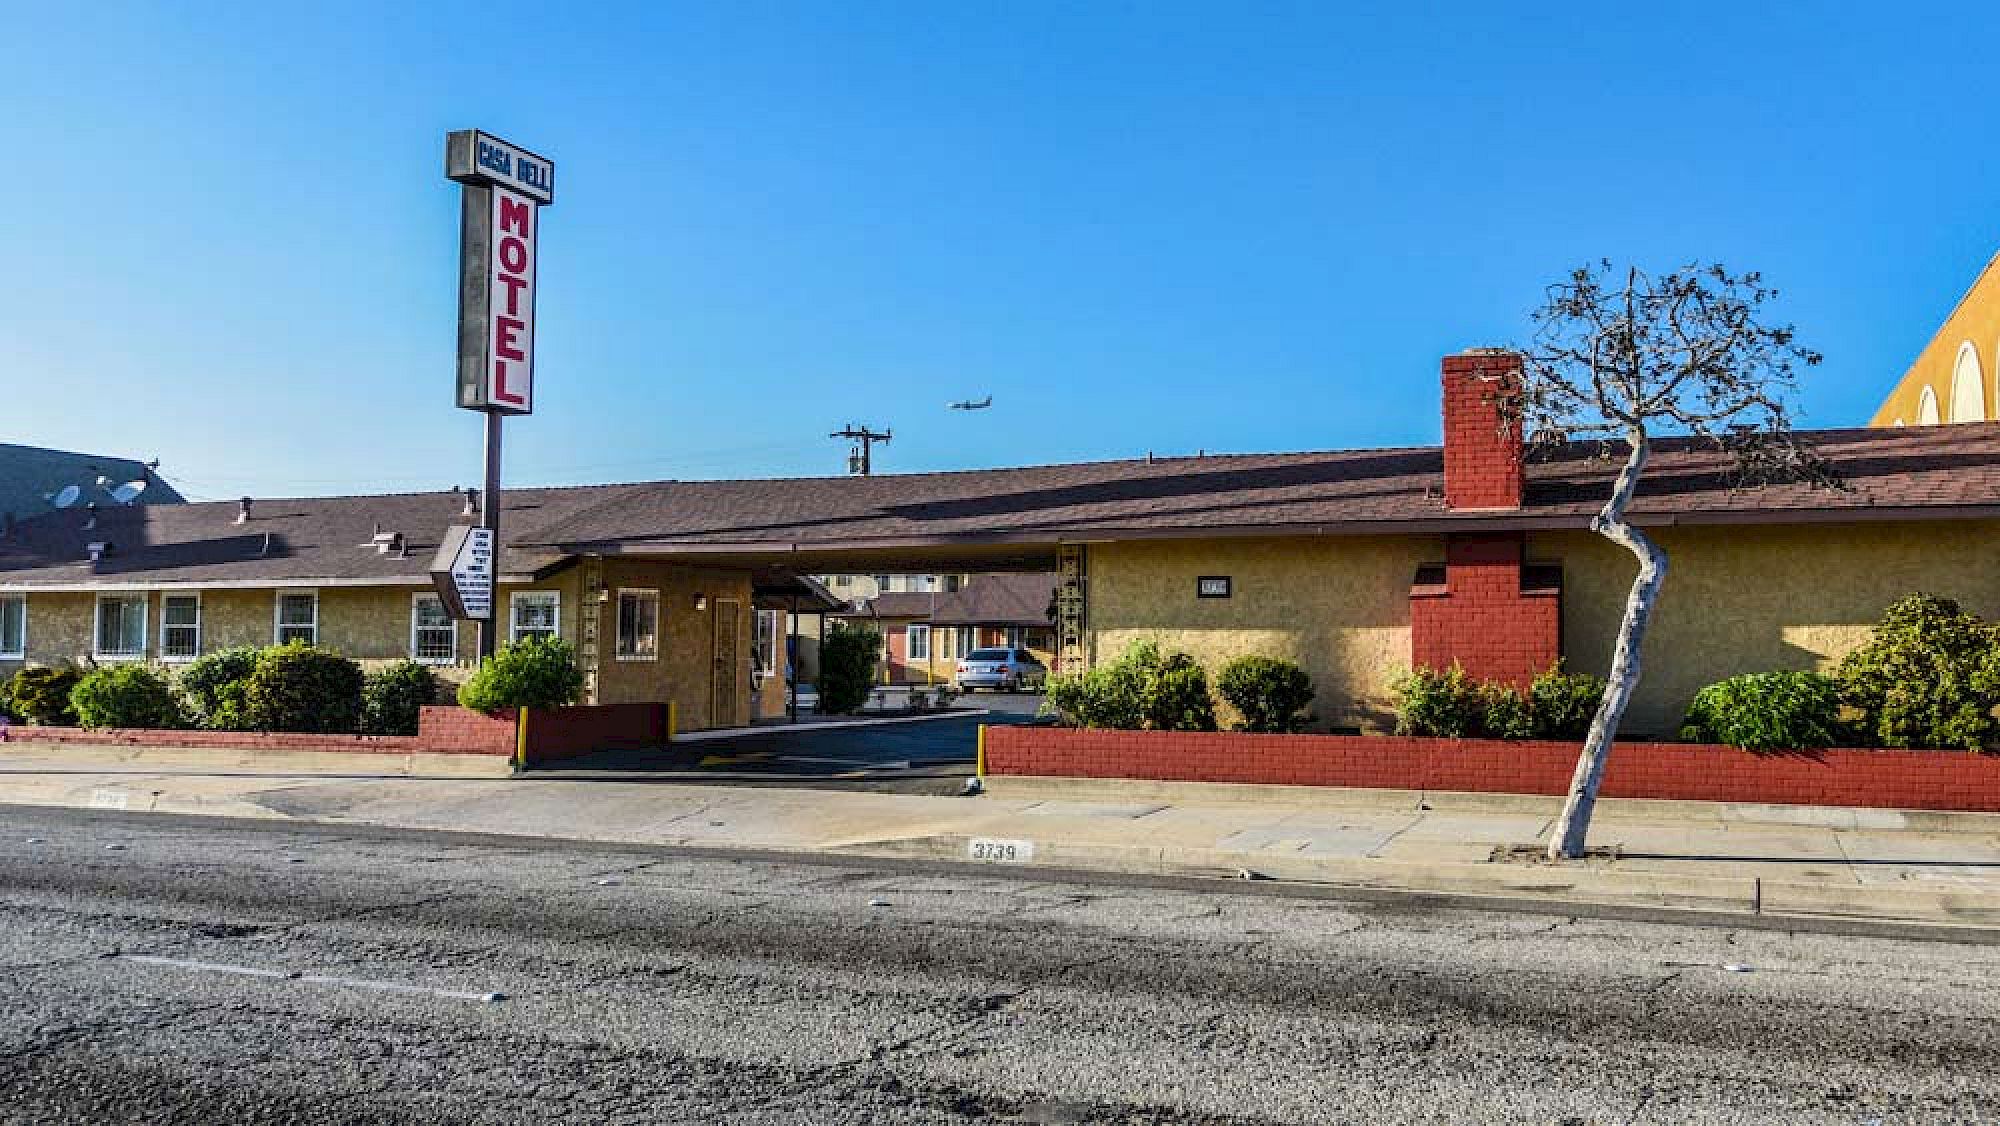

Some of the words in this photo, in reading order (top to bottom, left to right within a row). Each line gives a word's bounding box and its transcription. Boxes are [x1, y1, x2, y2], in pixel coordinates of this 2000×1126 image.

[479, 141, 511, 177] CASA
[517, 157, 550, 193] BELL
[495, 195, 529, 405] MOTEL
[973, 842, 1017, 861] 3739
